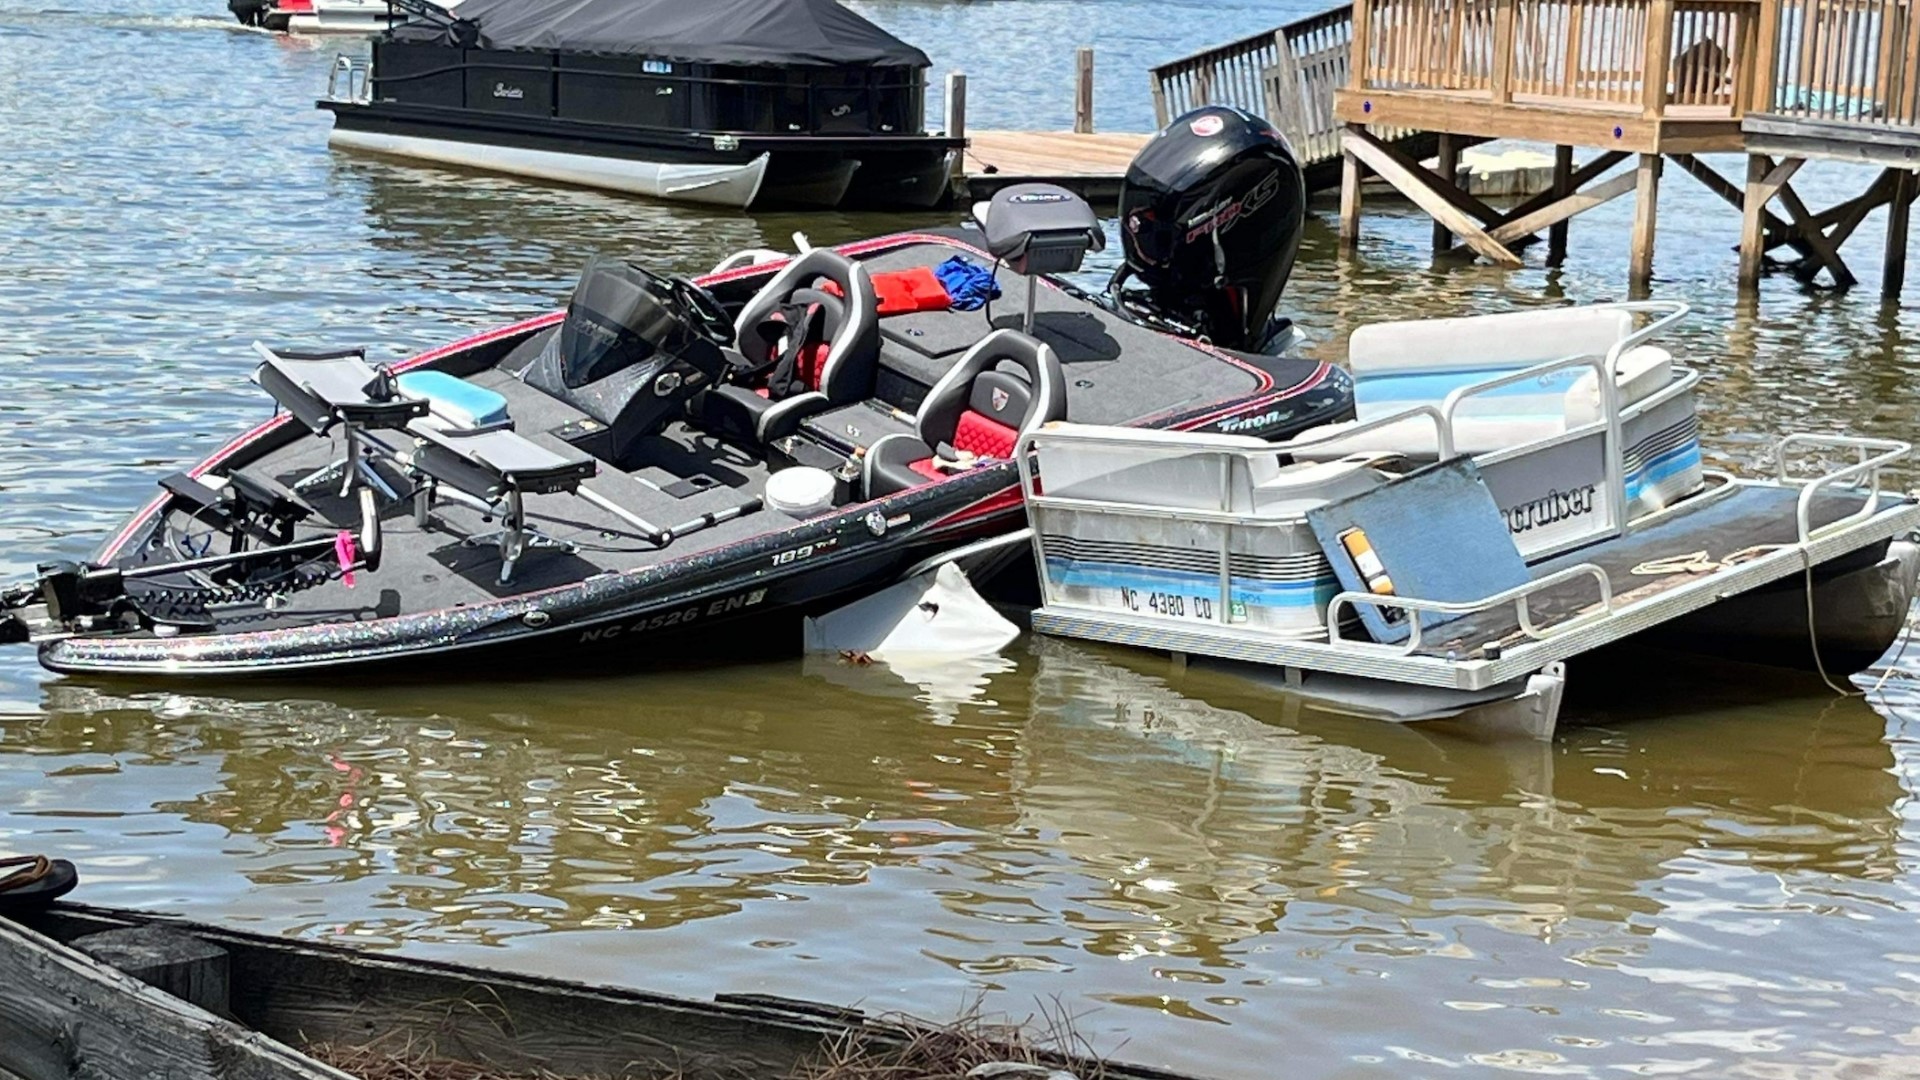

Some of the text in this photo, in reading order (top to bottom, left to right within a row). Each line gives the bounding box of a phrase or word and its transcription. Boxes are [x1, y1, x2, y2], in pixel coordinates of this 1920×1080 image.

[1217, 411, 1270, 432] Triton
[771, 544, 814, 567] 189
[1120, 586, 1139, 612] NC
[578, 624, 623, 644] NC
[630, 607, 700, 632] 4526
[705, 594, 746, 617] EN
